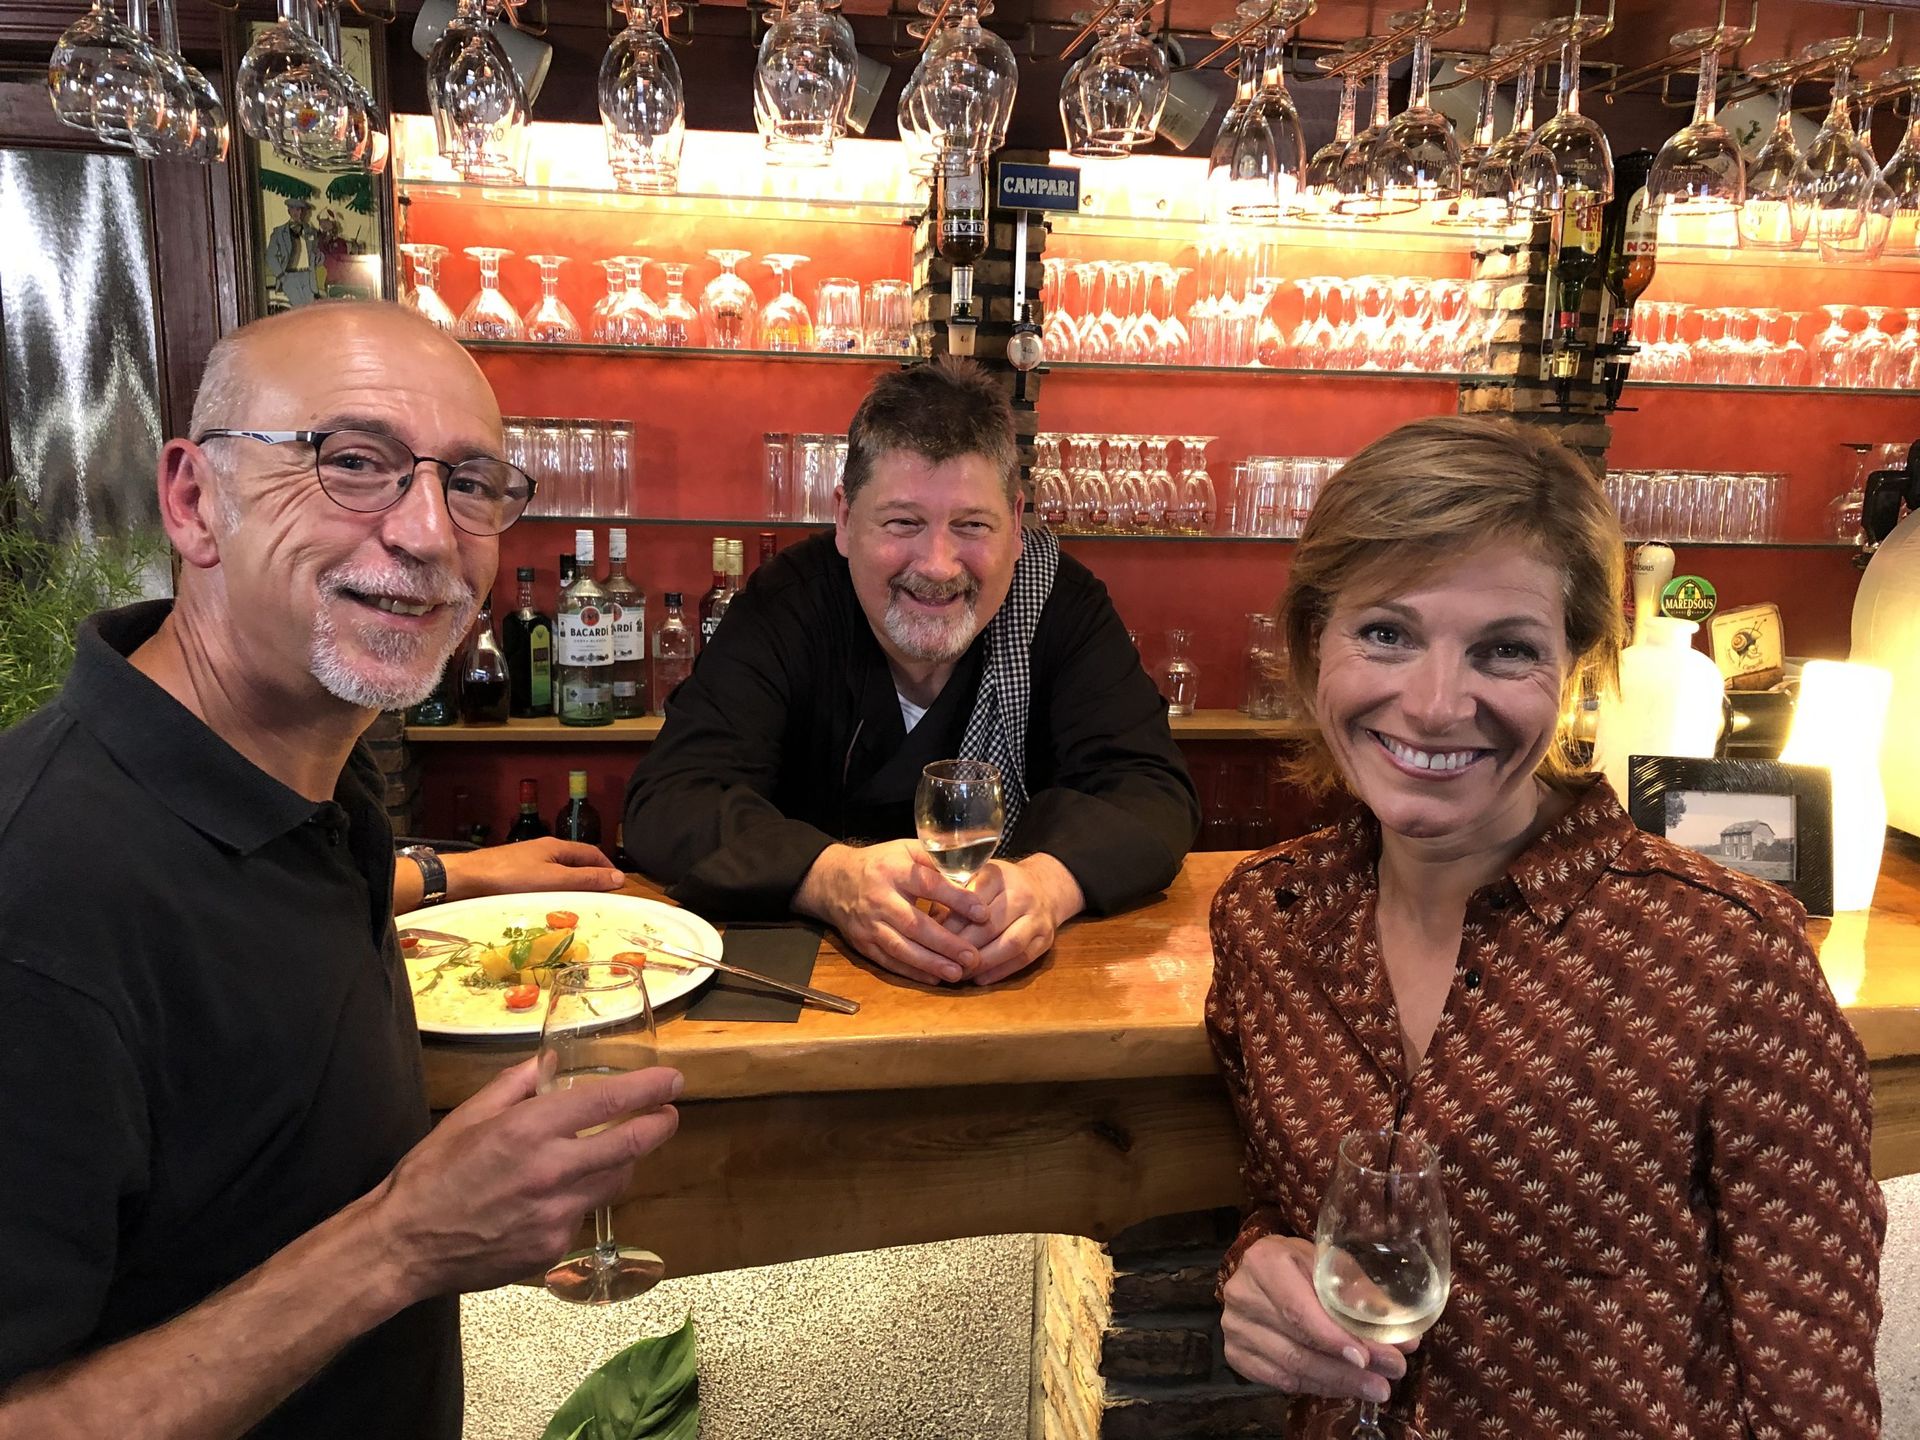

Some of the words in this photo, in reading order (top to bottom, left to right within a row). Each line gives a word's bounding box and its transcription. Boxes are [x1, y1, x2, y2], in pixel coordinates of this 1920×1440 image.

[1003, 176, 1075, 197] CAMPARI
[944, 223, 984, 233] RICARD
[1665, 599, 1714, 609] MAREDSOUS
[570, 625, 609, 637] BACARDÍ
[612, 621, 633, 633] ARDÍ
